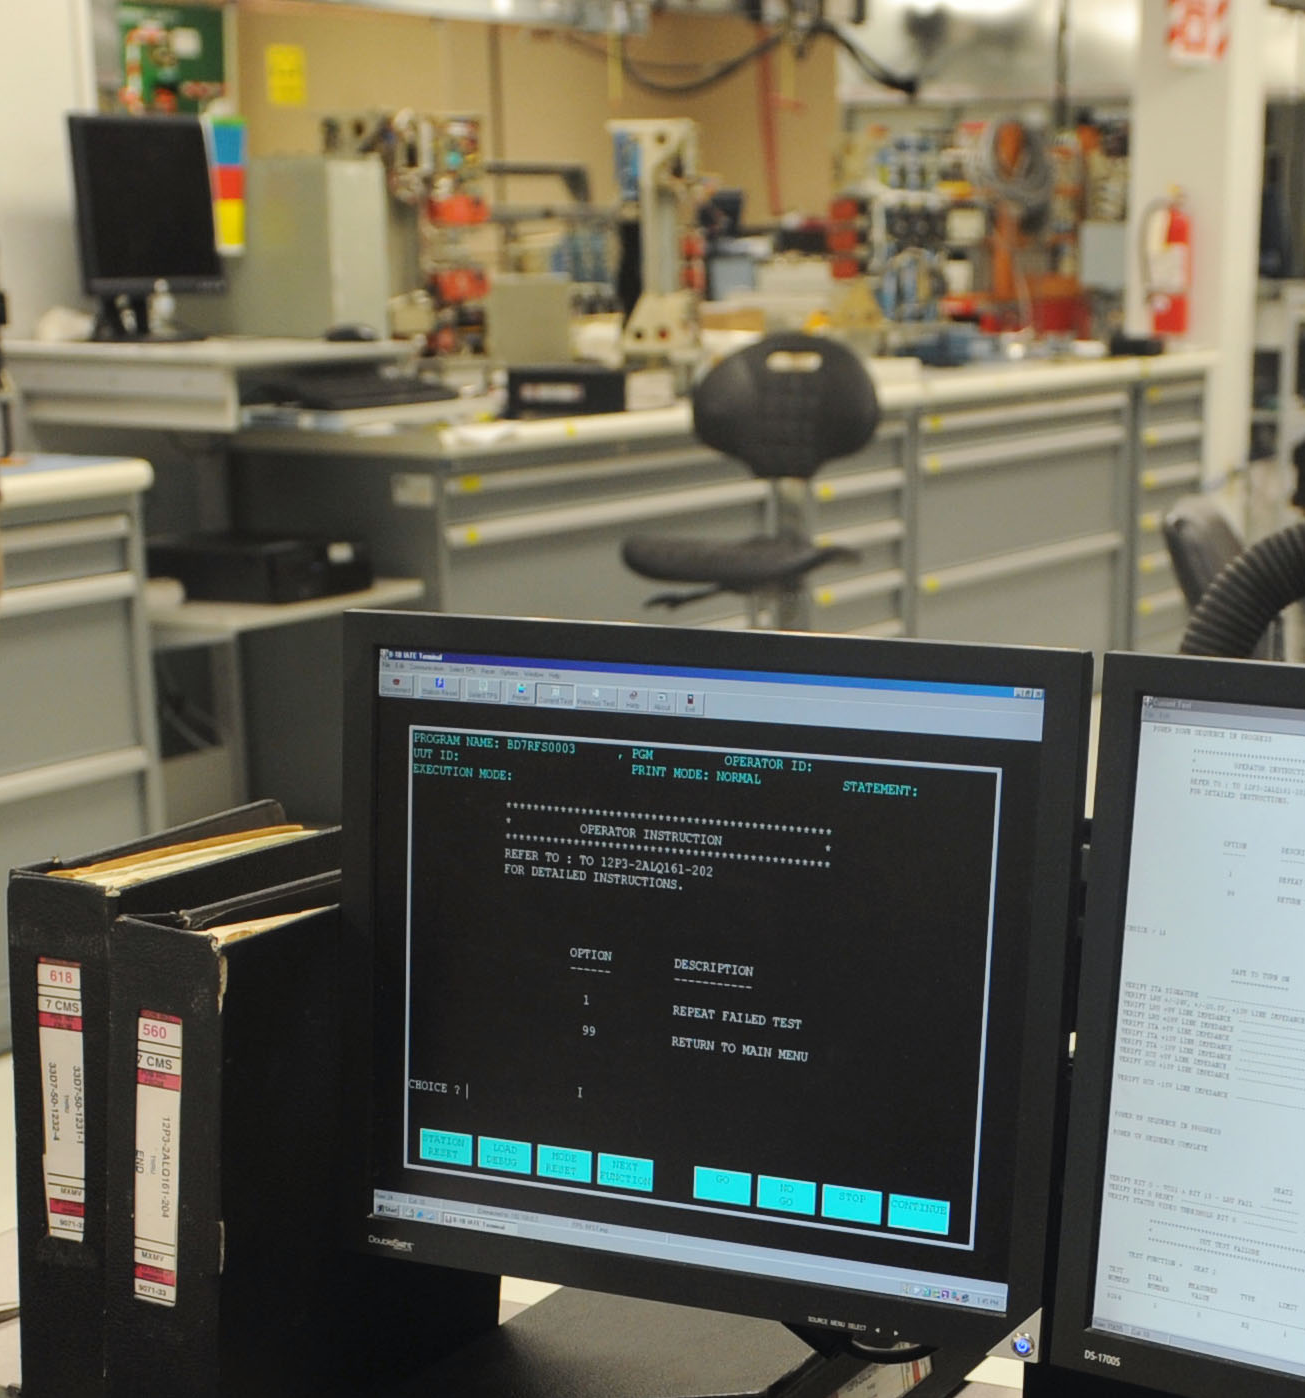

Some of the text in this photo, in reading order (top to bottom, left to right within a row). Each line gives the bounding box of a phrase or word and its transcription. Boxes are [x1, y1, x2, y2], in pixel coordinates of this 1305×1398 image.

[413, 733, 576, 754] PROGRAM NAME: BD7RFS0003
[413, 749, 460, 762] UUT ID:
[632, 749, 654, 760] PGM
[413, 764, 513, 781] EXECUTION MODE:
[724, 756, 813, 773] OPERATOR ID:
[632, 765, 761, 785] PRINT MODE: NORMAL
[842, 780, 918, 797] STATEMENT:
[580, 823, 723, 846] OPERATOR INSTRUCTION
[504, 848, 539, 861] REFER
[545, 851, 560, 863] TO
[579, 854, 594, 866] TO
[504, 864, 684, 890] FOR DETAILED INSTRUCTIONS.
[569, 947, 754, 977] OPTION DESCRIPTION
[49, 970, 73, 984] 618
[46, 999, 80, 1013] 7 CMS
[672, 1005, 716, 1020] REPEAT
[722, 1011, 767, 1026] FAILED
[772, 1016, 802, 1030] TEST
[142, 1024, 167, 1040] 560
[582, 1025, 809, 1062] 99 RETURN TO MAIN MENU
[146, 1055, 173, 1070] CMS
[408, 1079, 448, 1094] CHOICE
[135, 1151, 145, 1174] END
[715, 1174, 730, 1185] GO
[839, 1191, 867, 1204] STOP
[891, 1199, 948, 1216] CONTINUE
[1083, 1349, 1121, 1367] DS-1700S
